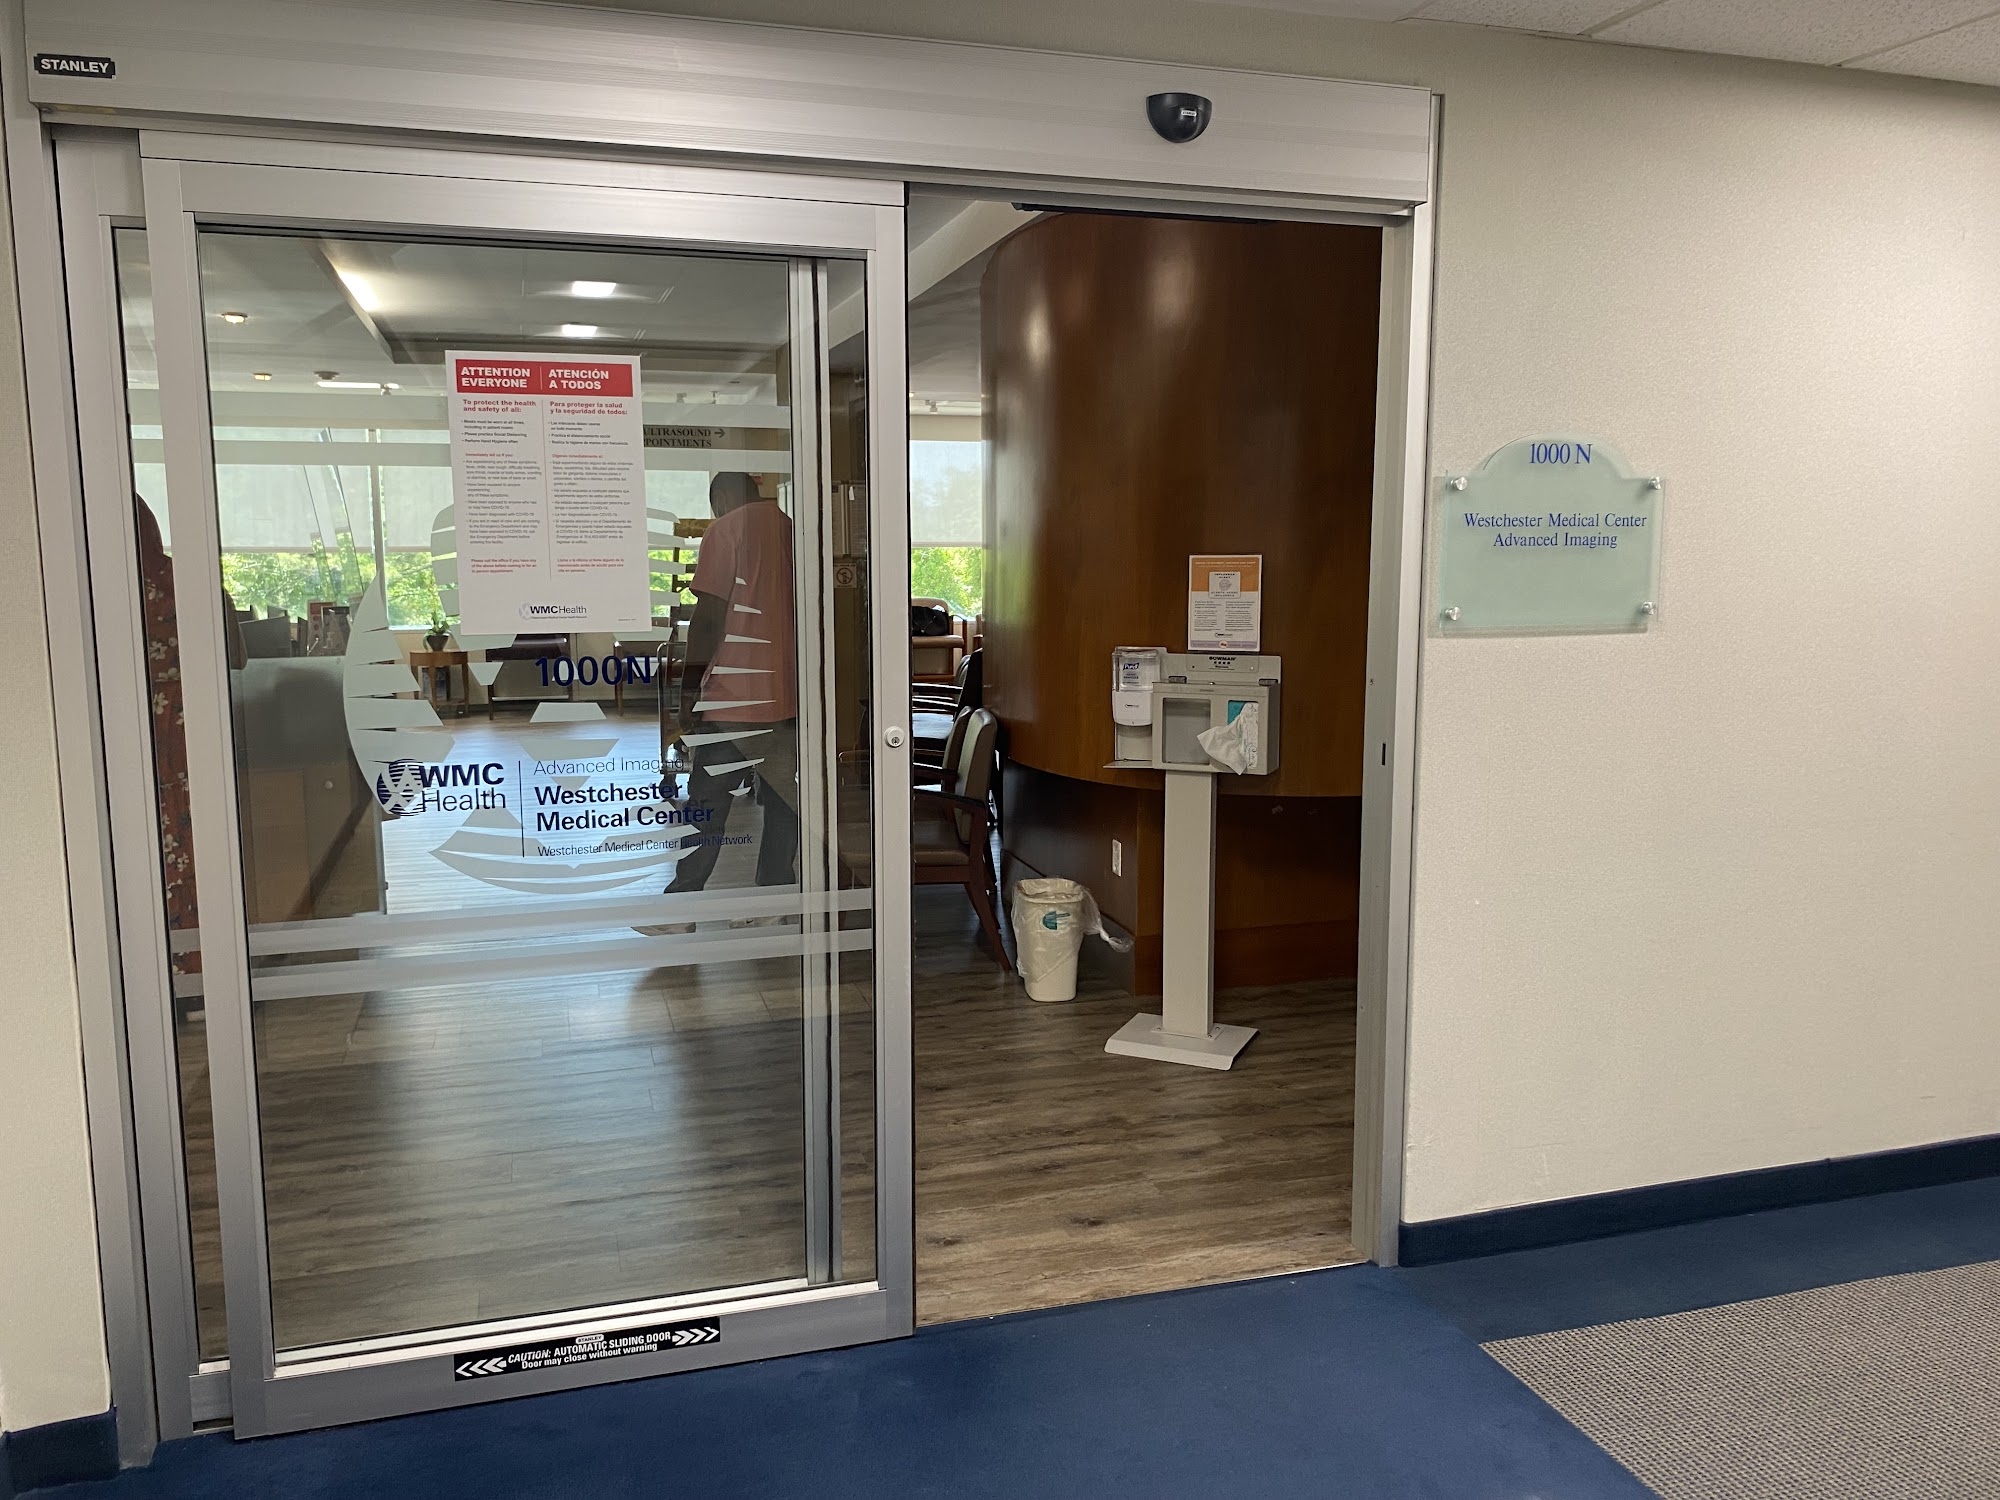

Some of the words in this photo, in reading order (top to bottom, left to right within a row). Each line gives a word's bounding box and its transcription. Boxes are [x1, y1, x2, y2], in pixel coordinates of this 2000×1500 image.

[41, 59, 109, 73] STANLEY
[461, 367, 530, 377] ATTENTION
[549, 369, 609, 379] ATENCIÓN
[462, 378, 527, 388] EVERYONE
[549, 380, 558, 388] A
[561, 380, 601, 389] TODOS
[643, 428, 711, 437] ULTRASOUND
[644, 438, 711, 447] POINTMENTS
[1530, 443, 1570, 464] 1000
[1575, 443, 1593, 464] N
[1464, 513, 1542, 527] Westchester
[1549, 513, 1599, 527] Medical
[1604, 513, 1647, 527] Center
[1493, 533, 1558, 547] Advanced
[1564, 532, 1618, 548] Imaging
[535, 656, 650, 686] 1000N
[534, 758, 615, 775] Advanced
[420, 763, 504, 787] WMC
[422, 787, 506, 812] Health
[534, 783, 682, 805] Westchester
[538, 808, 629, 831] Medical
[637, 806, 714, 825] Center
[538, 844, 602, 856] Westchester
[605, 840, 644, 852] Medical
[646, 839, 678, 850] Center
[712, 834, 752, 846] Network
[508, 1349, 551, 1363] CAUTION:
[554, 1341, 607, 1357] AUTOMATIC
[609, 1335, 644, 1348] SLIDING
[646, 1331, 670, 1343] DOOR
[578, 1335, 602, 1343] STANLEY
[522, 1360, 542, 1369] Door
[544, 1358, 562, 1366] may
[564, 1353, 587, 1362] close
[589, 1348, 621, 1359] without
[623, 1343, 657, 1354] warning
